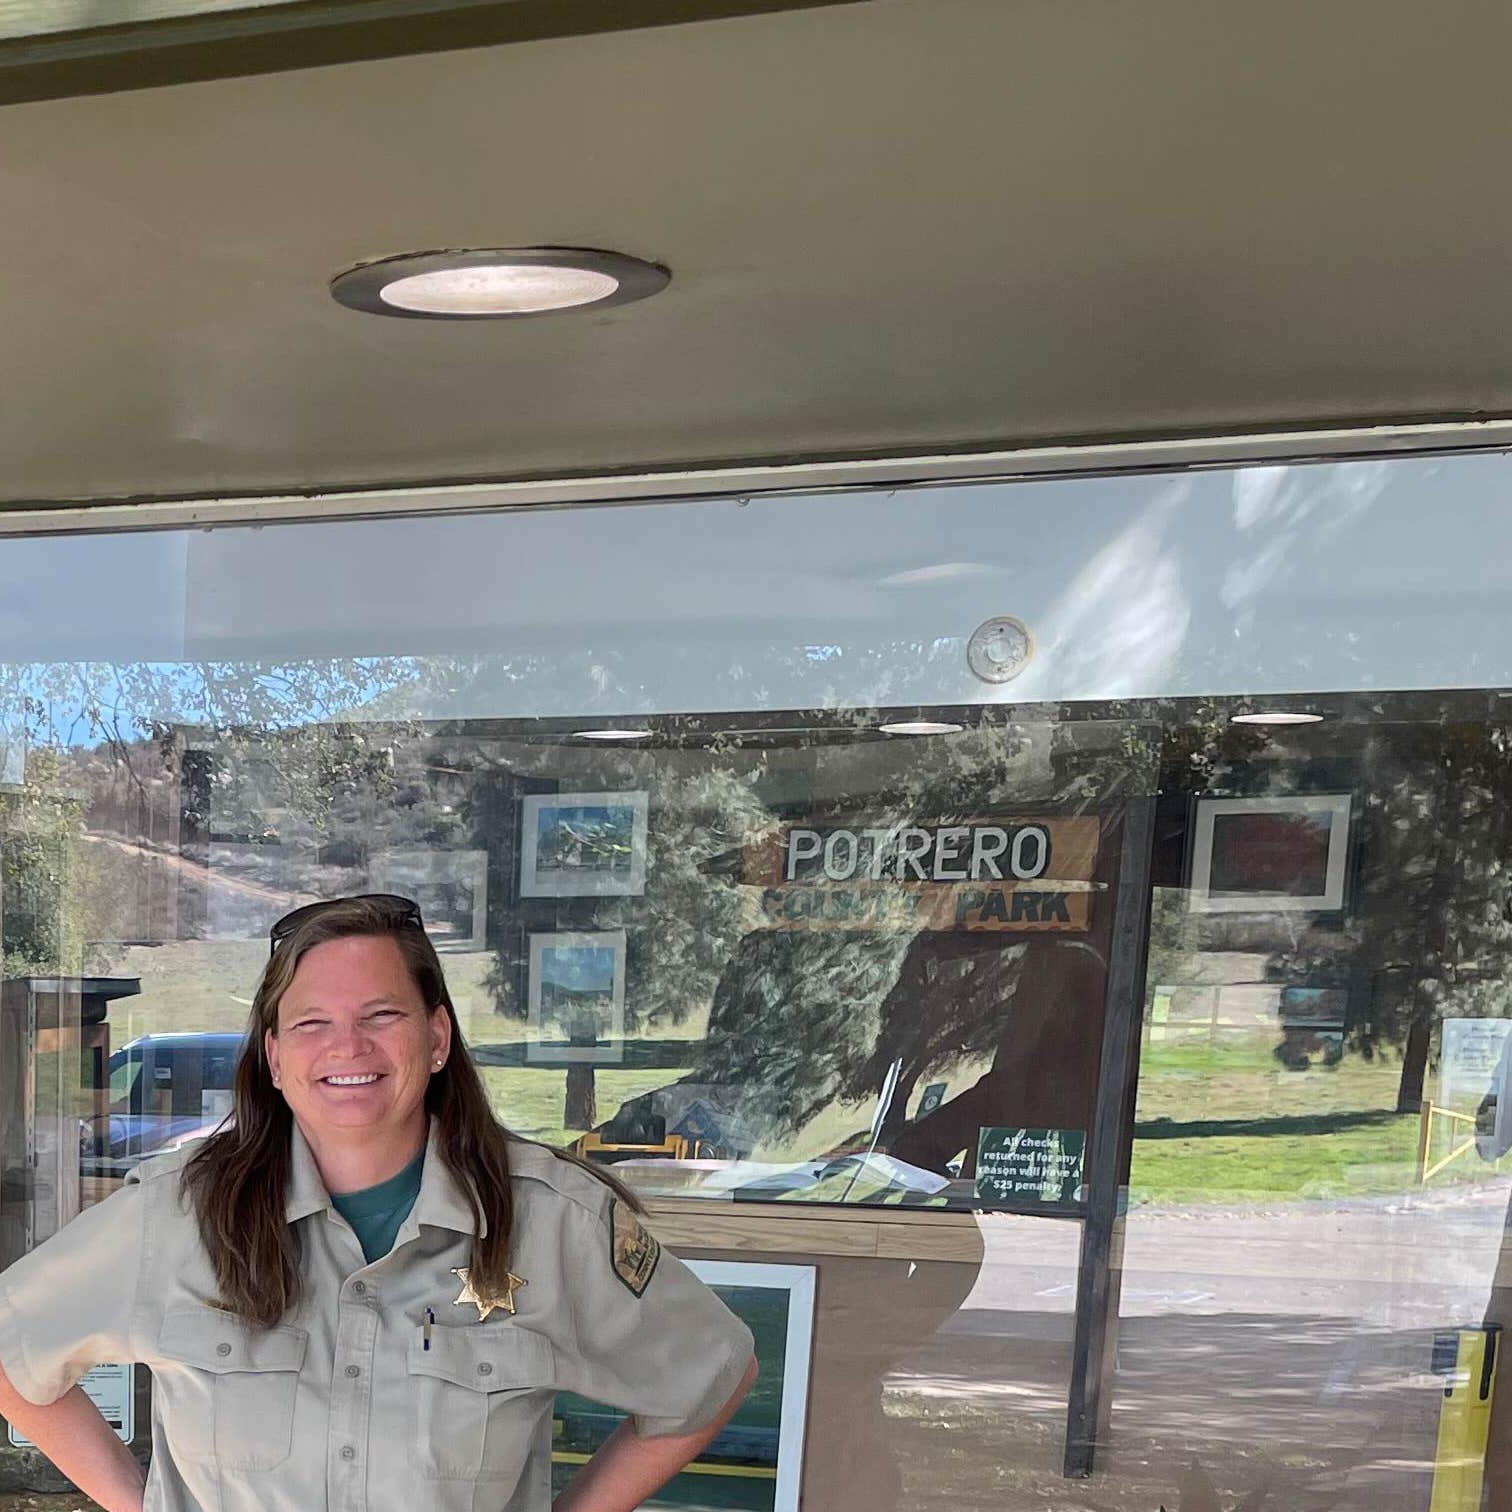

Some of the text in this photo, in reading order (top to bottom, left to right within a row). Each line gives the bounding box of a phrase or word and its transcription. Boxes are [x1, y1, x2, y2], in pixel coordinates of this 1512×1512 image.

[788, 827, 1048, 881] POTRERO
[955, 889, 1070, 923] PARK
[1021, 1138, 1059, 1147] checks
[984, 1152, 1076, 1165] returned for any
[979, 1166, 1016, 1175] reason
[1019, 1167, 1040, 1176] will
[1072, 1170, 1079, 1178] a
[994, 1180, 1012, 1189] $25
